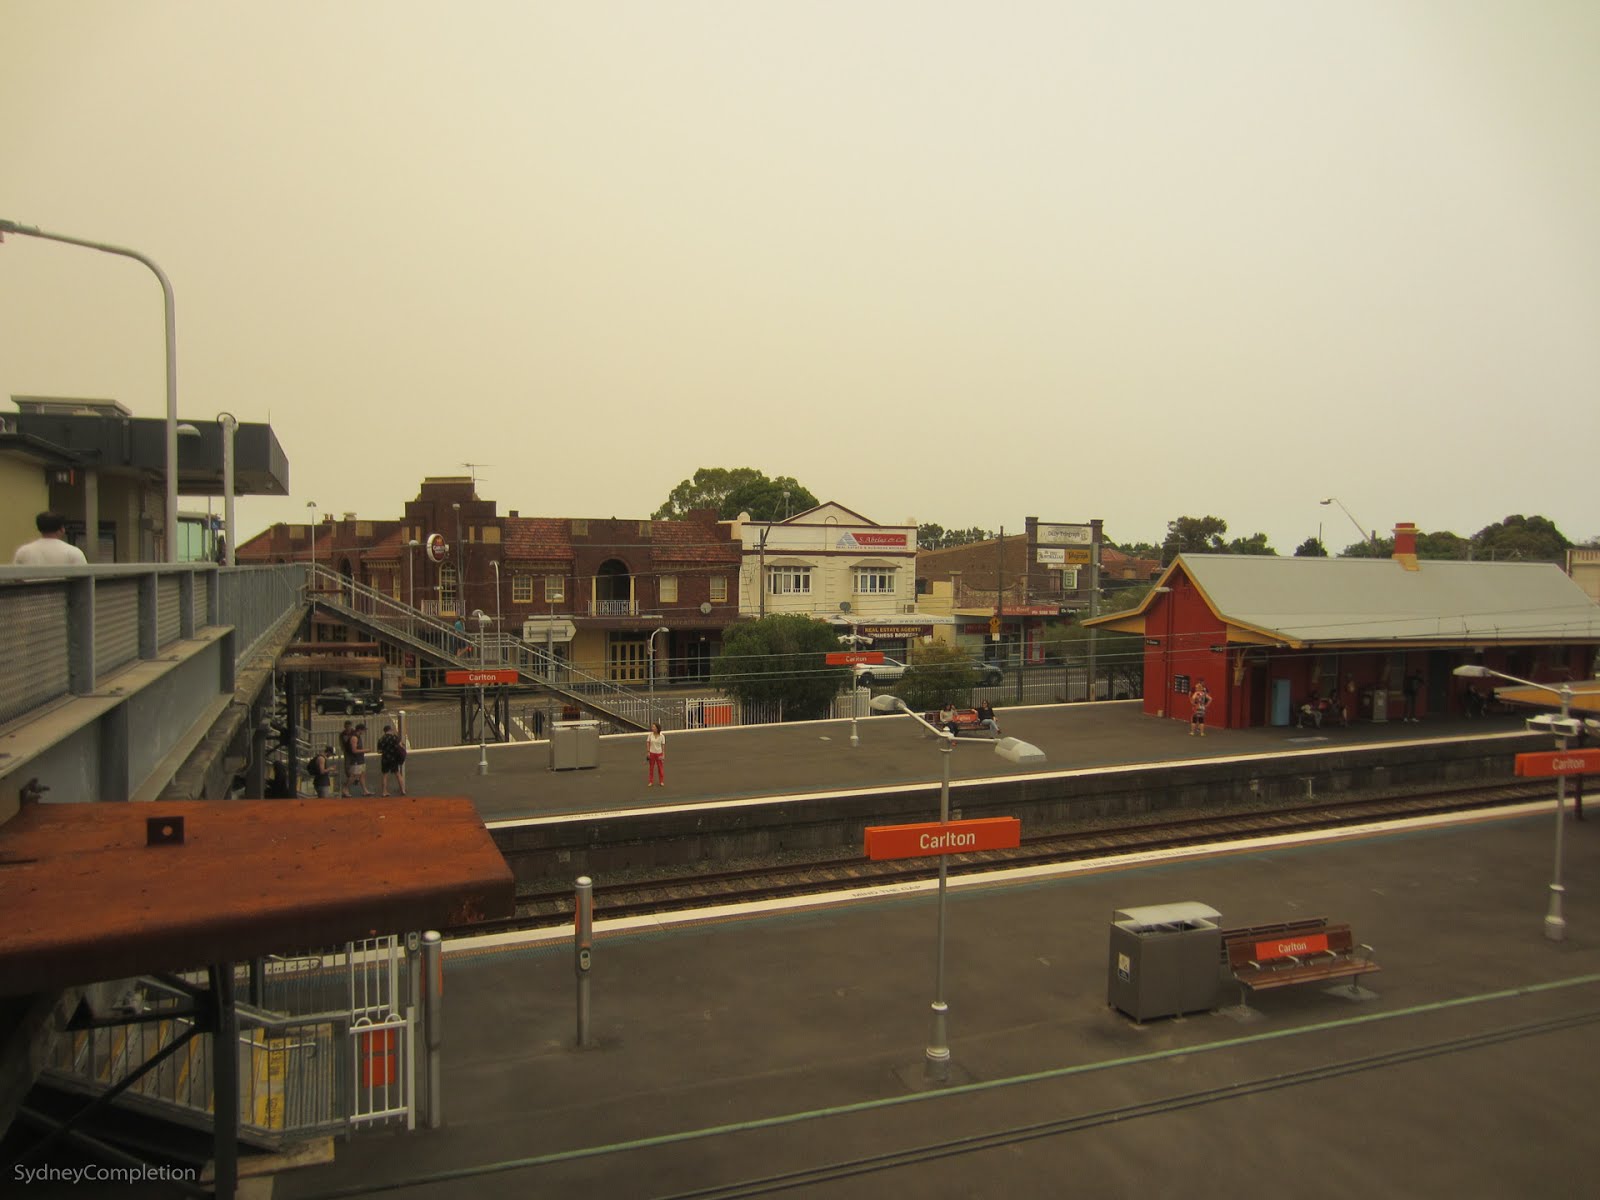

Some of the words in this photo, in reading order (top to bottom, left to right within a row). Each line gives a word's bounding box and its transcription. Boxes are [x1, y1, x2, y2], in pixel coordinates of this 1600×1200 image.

[469, 673, 496, 681] Carlton
[1552, 758, 1585, 771] Carlton
[919, 831, 976, 849] Carlton
[1278, 942, 1307, 953] Carlton
